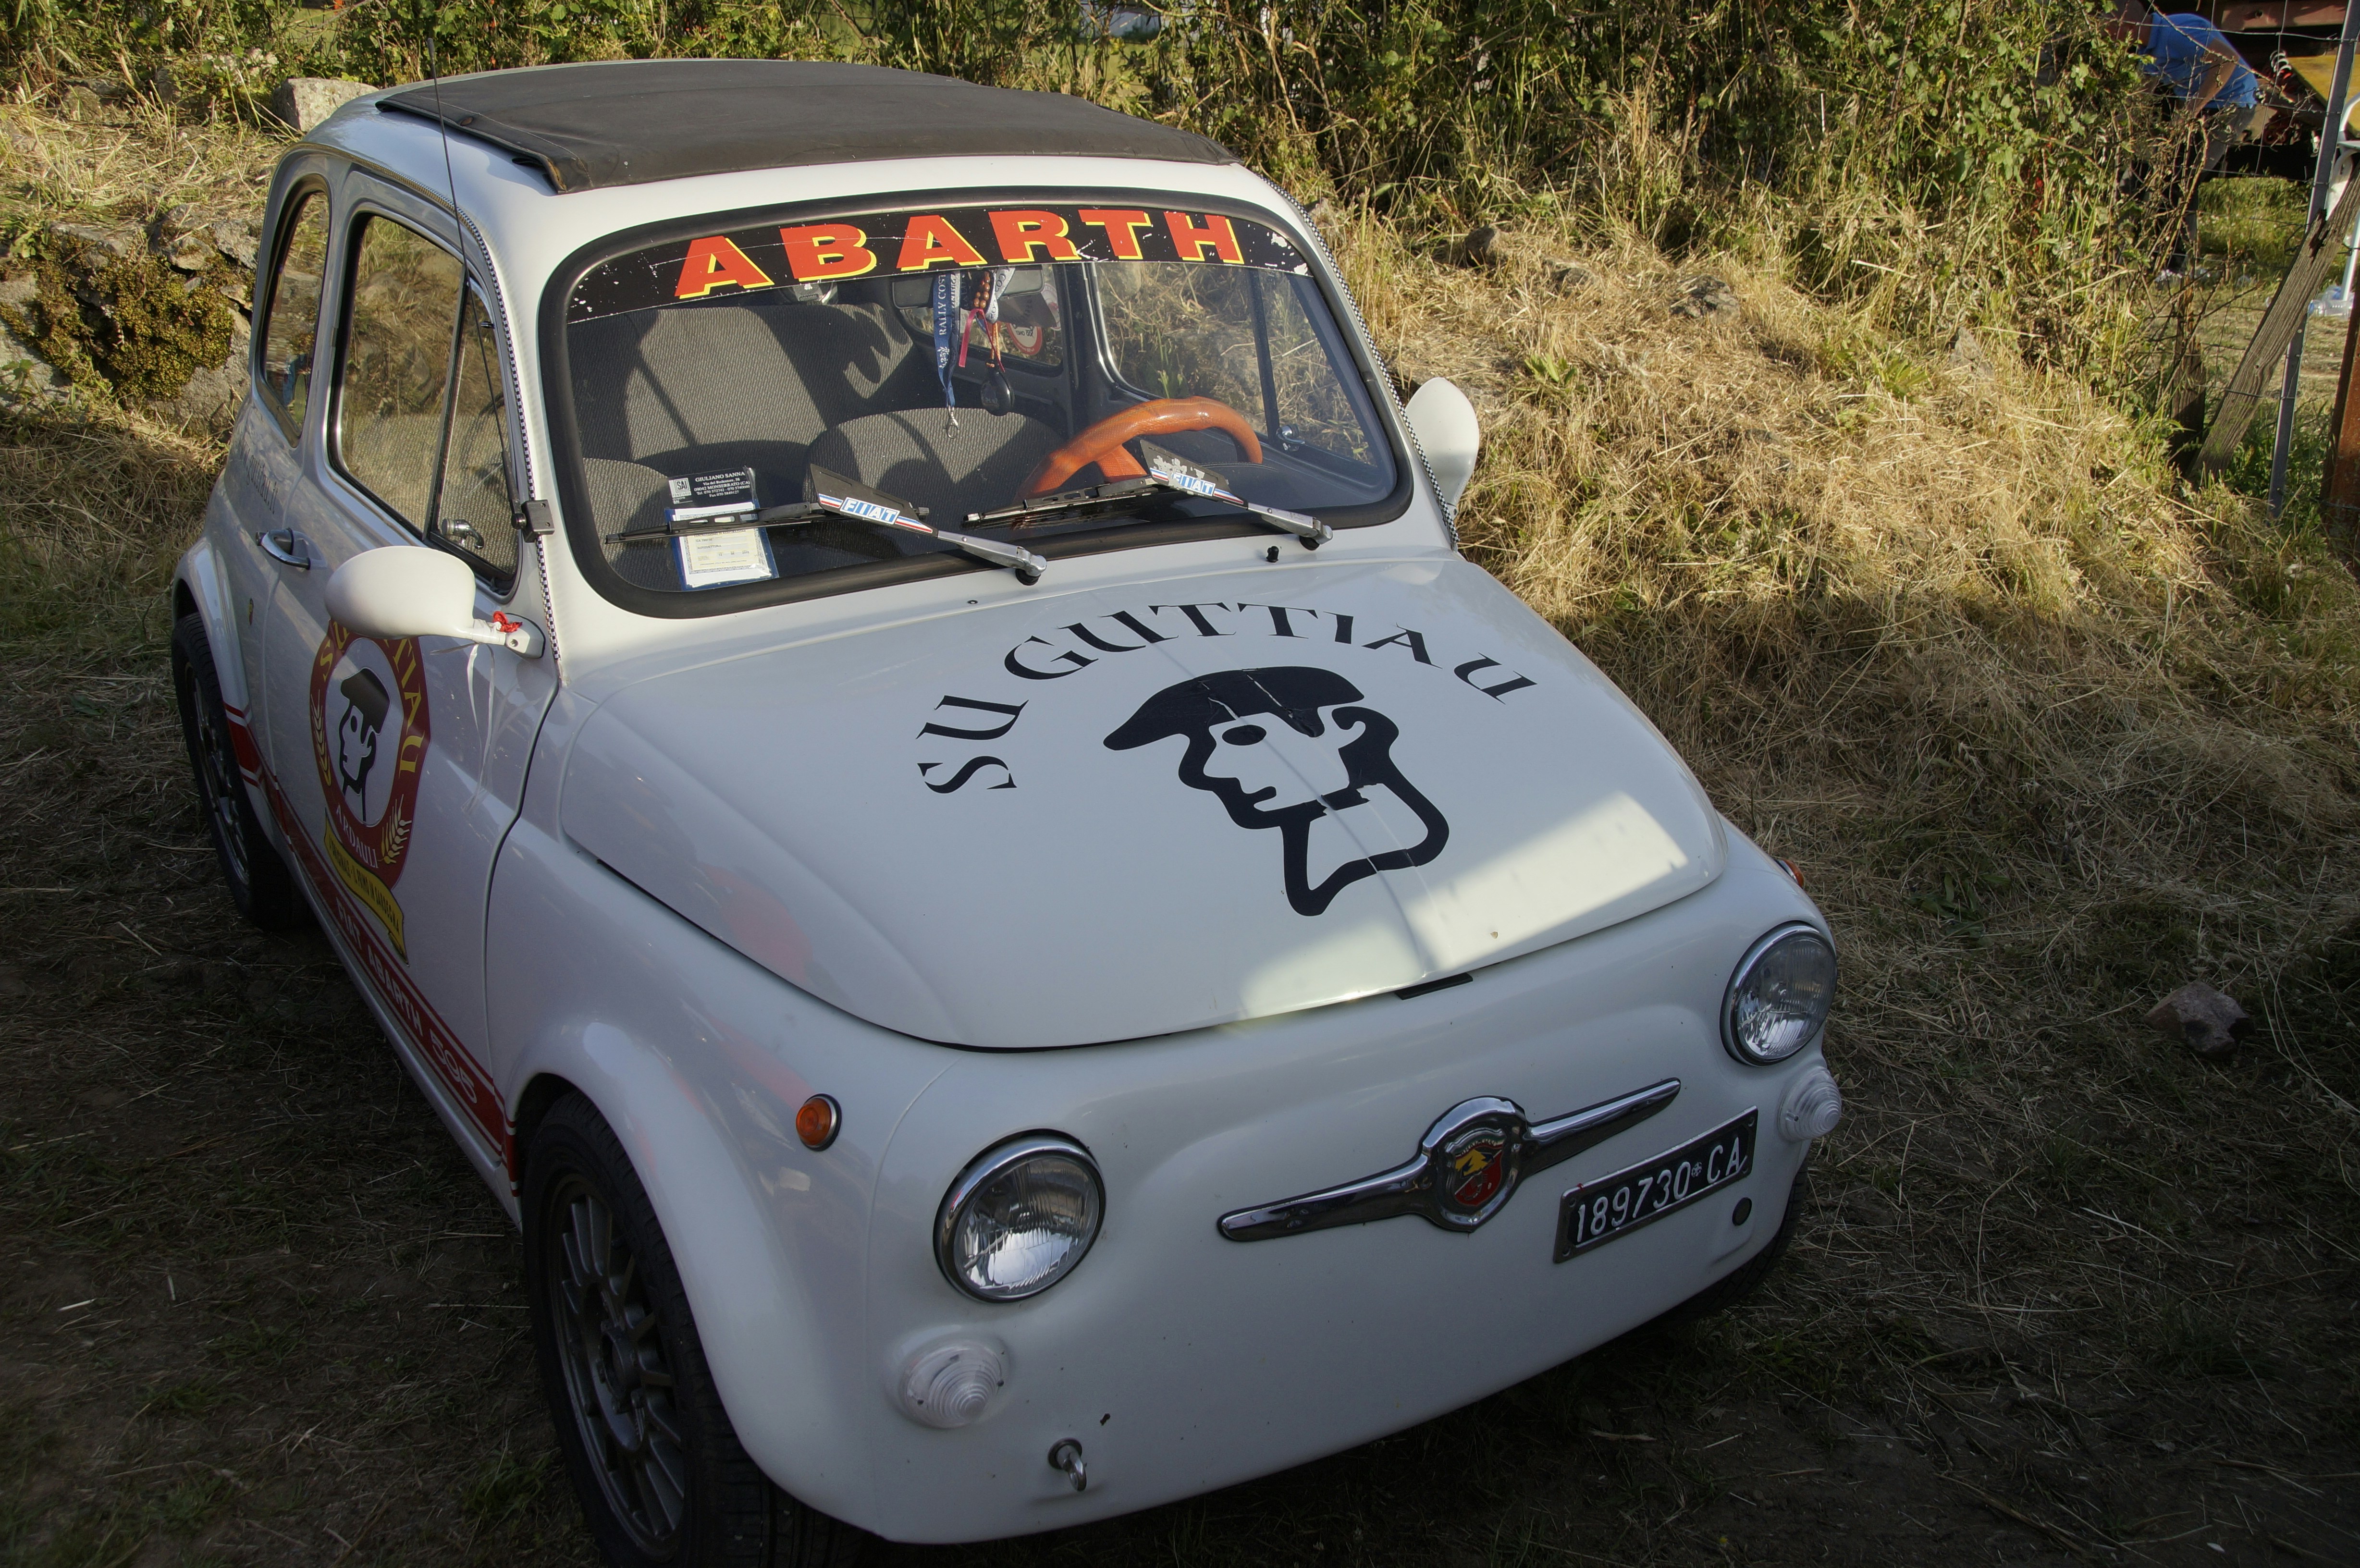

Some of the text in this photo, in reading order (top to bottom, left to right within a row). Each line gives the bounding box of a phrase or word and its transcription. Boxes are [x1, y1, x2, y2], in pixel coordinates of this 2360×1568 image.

[675, 208, 1245, 299] ABARTH
[938, 303, 946, 335] RALLY
[676, 480, 688, 490] SAI
[695, 474, 724, 482] GIULIANO
[844, 500, 897, 522] FIAT
[916, 602, 1538, 794] SU GUTTIAU
[336, 803, 378, 869] ARDAULI
[336, 896, 361, 950] FIAT
[368, 944, 423, 1037] ABARTH
[1576, 1136, 1741, 1243] 189730 CA
